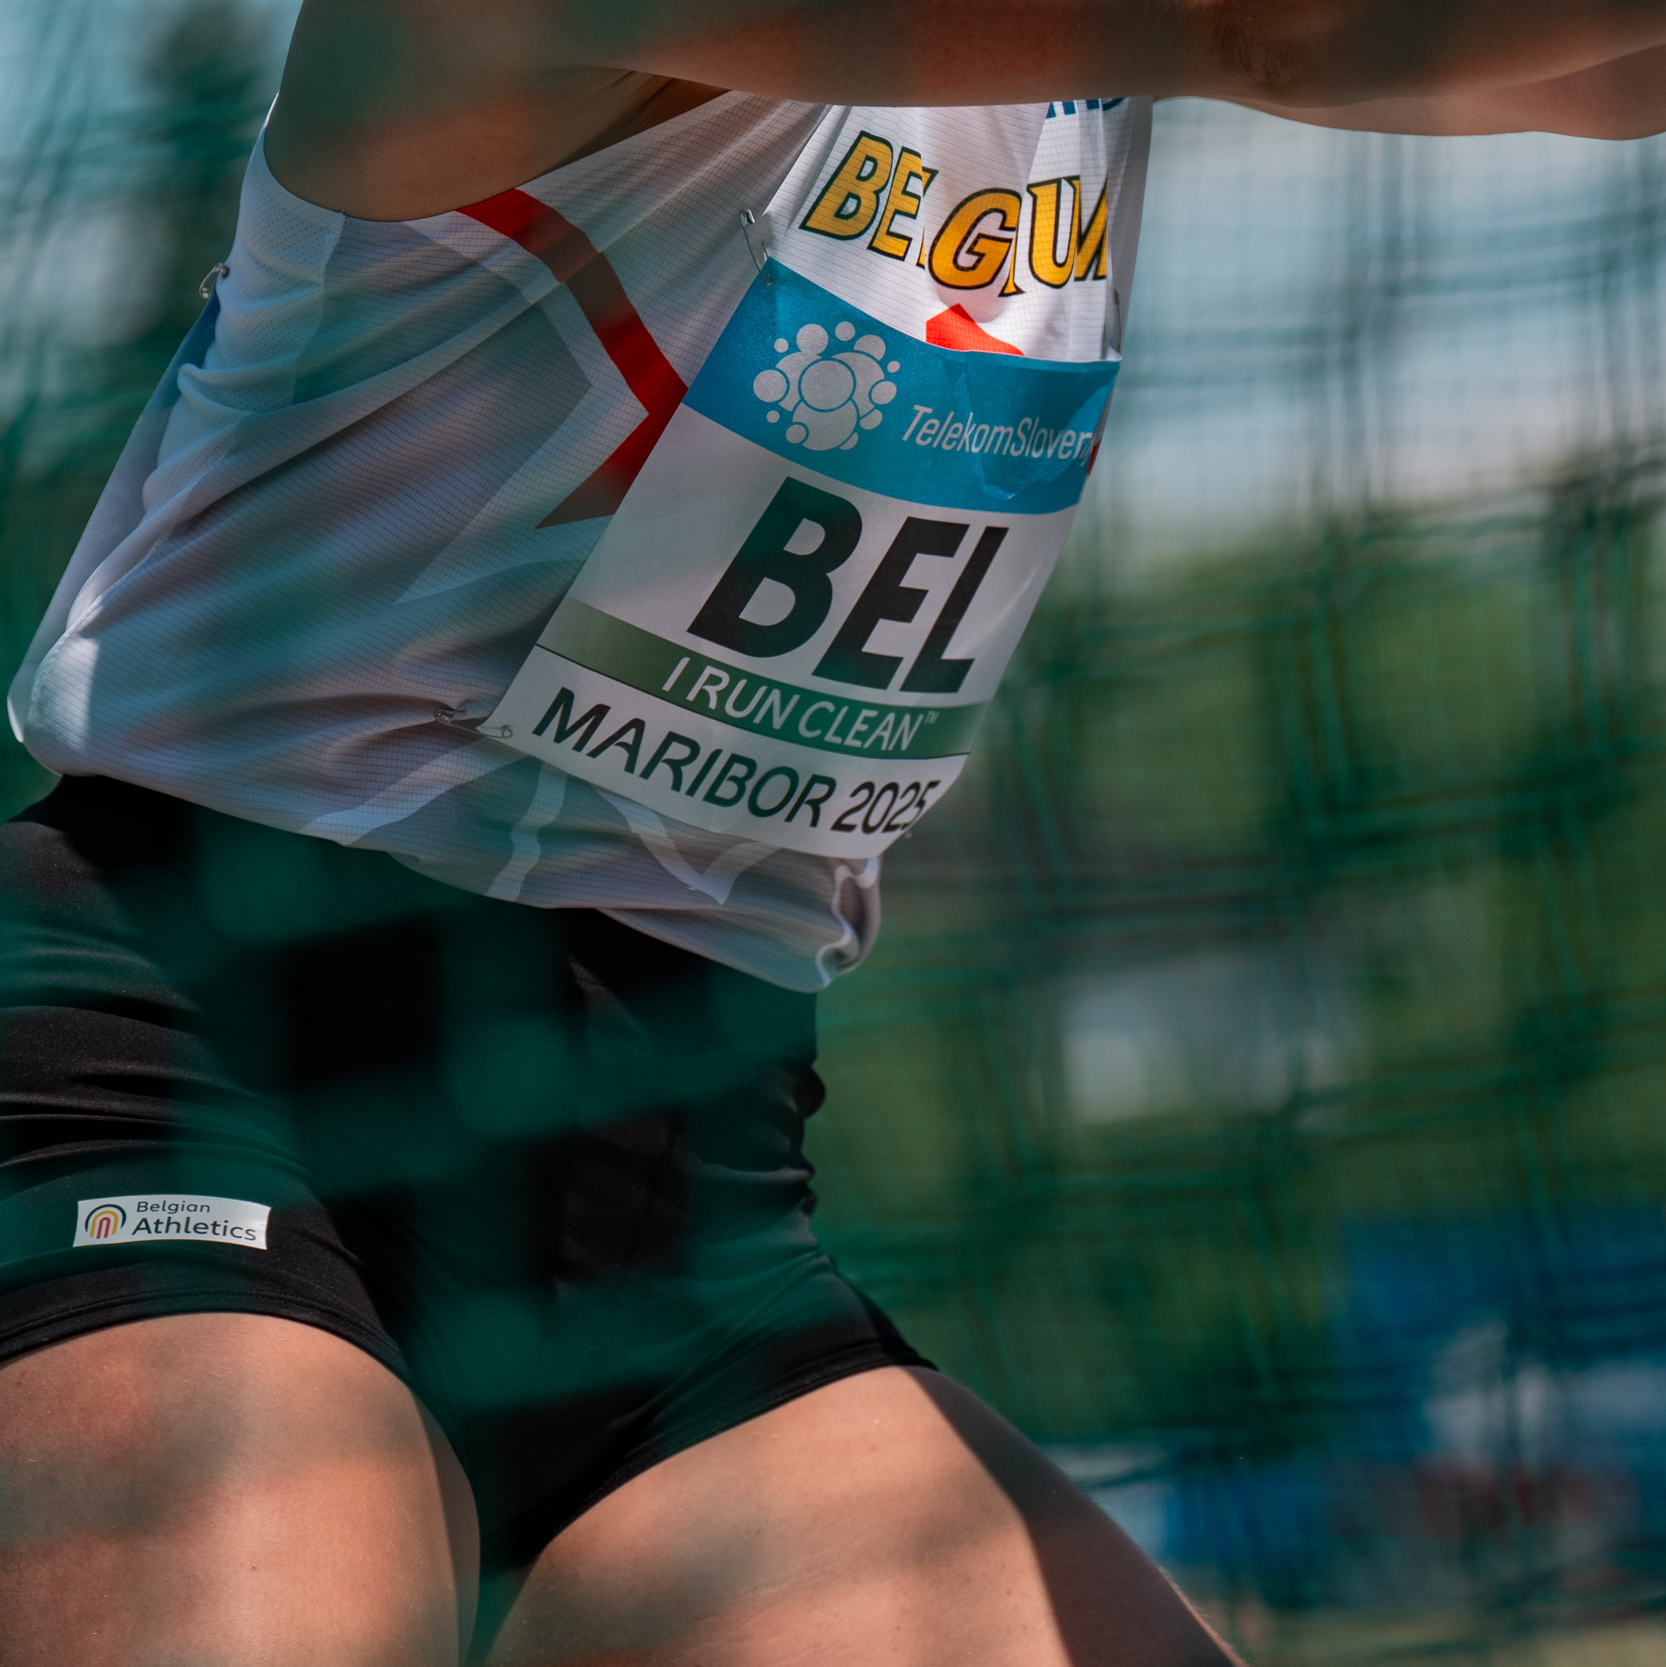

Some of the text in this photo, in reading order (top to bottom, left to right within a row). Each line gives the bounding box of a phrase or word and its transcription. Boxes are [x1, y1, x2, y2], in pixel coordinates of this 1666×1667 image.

[686, 476, 1009, 693] BEL
[661, 656, 691, 692] I
[686, 665, 800, 730] RUN
[533, 687, 941, 835] MARIBOR 2025
[131, 1216, 257, 1241] Athletics
[136, 1200, 210, 1214] Belgian
